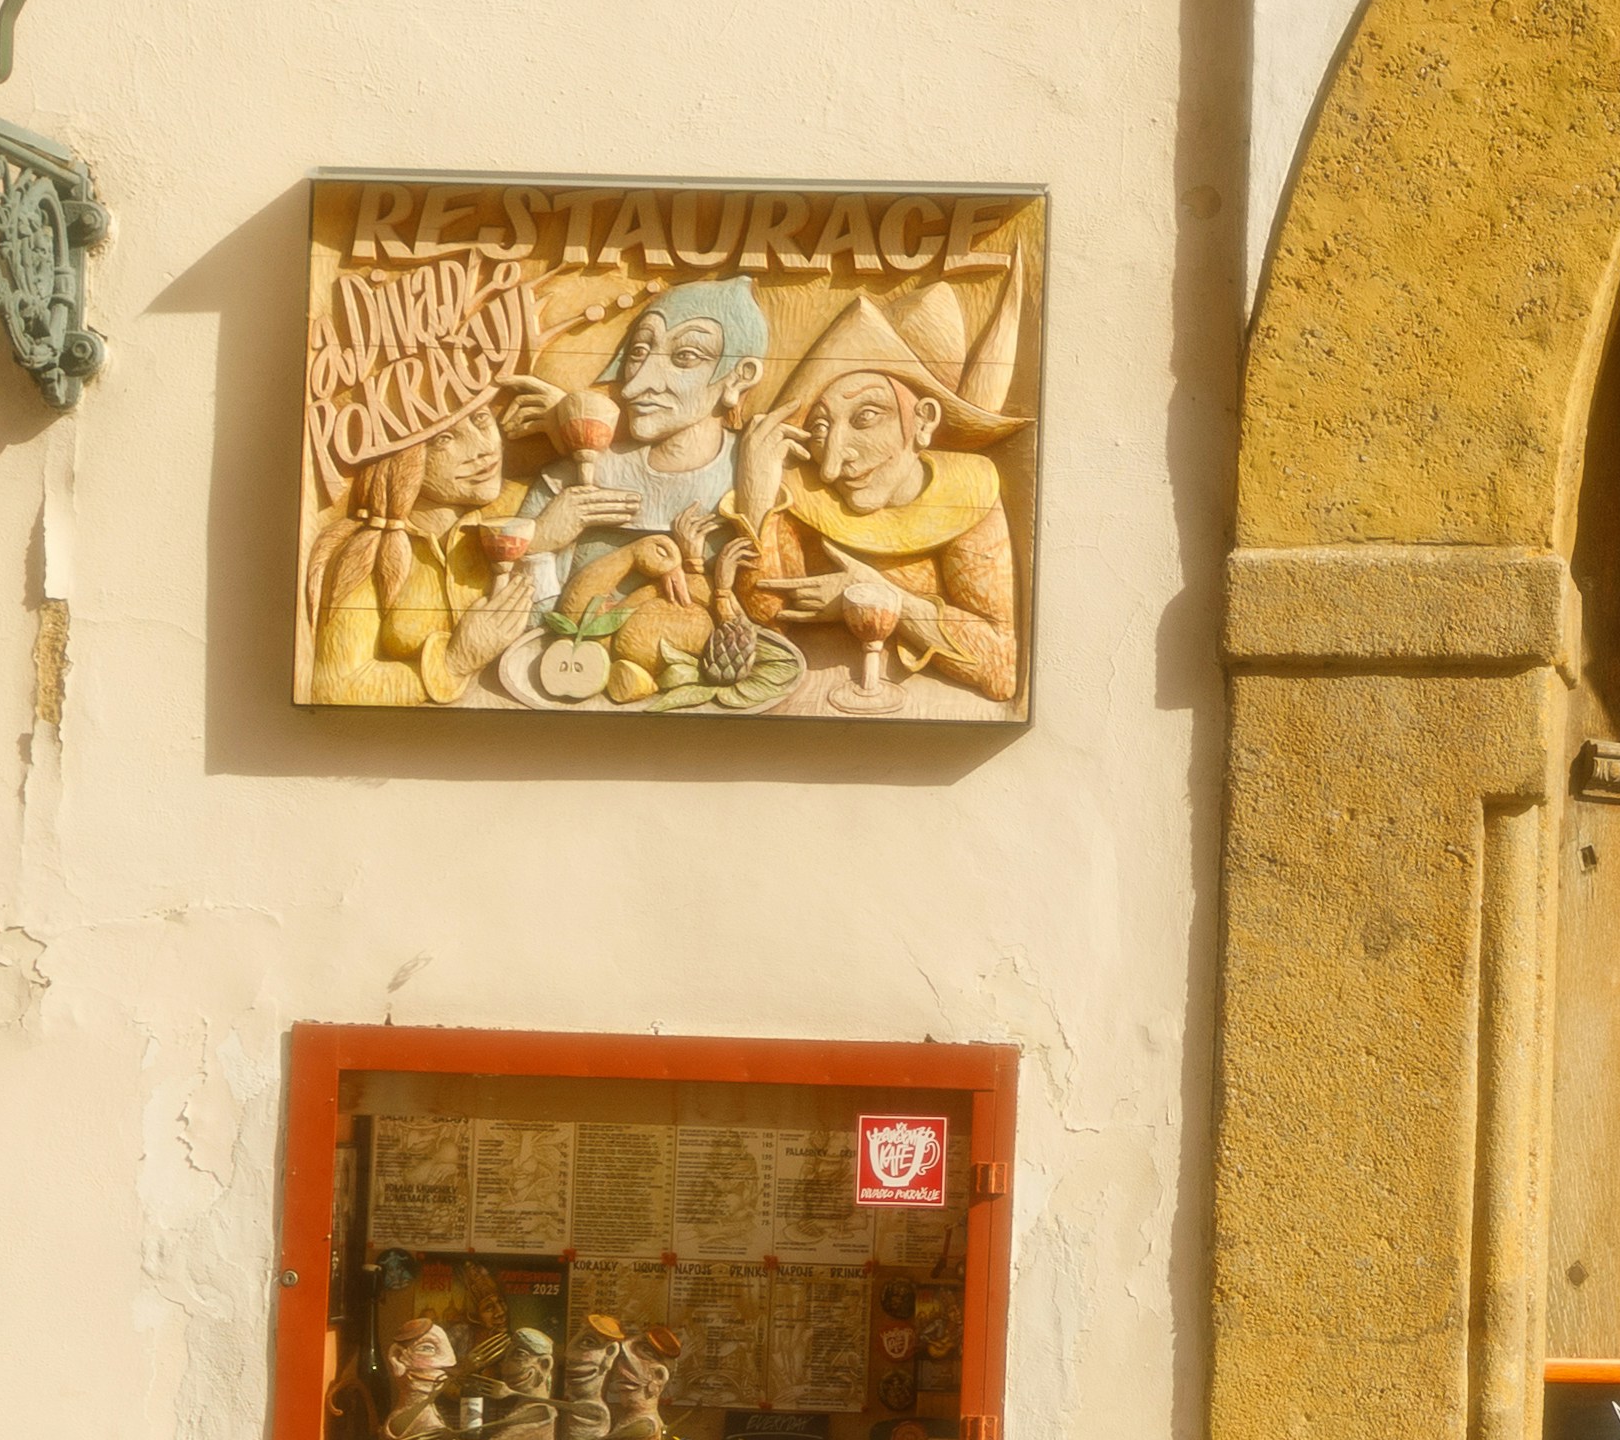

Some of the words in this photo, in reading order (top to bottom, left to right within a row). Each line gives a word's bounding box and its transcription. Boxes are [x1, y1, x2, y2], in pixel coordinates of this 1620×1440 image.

[348, 182, 1017, 274] RESTAURACE
[880, 1143, 914, 1176] KAFE
[730, 1265, 768, 1278] DRINKS
[830, 1267, 868, 1279] DRINKS
[533, 1284, 560, 1296] 2025
